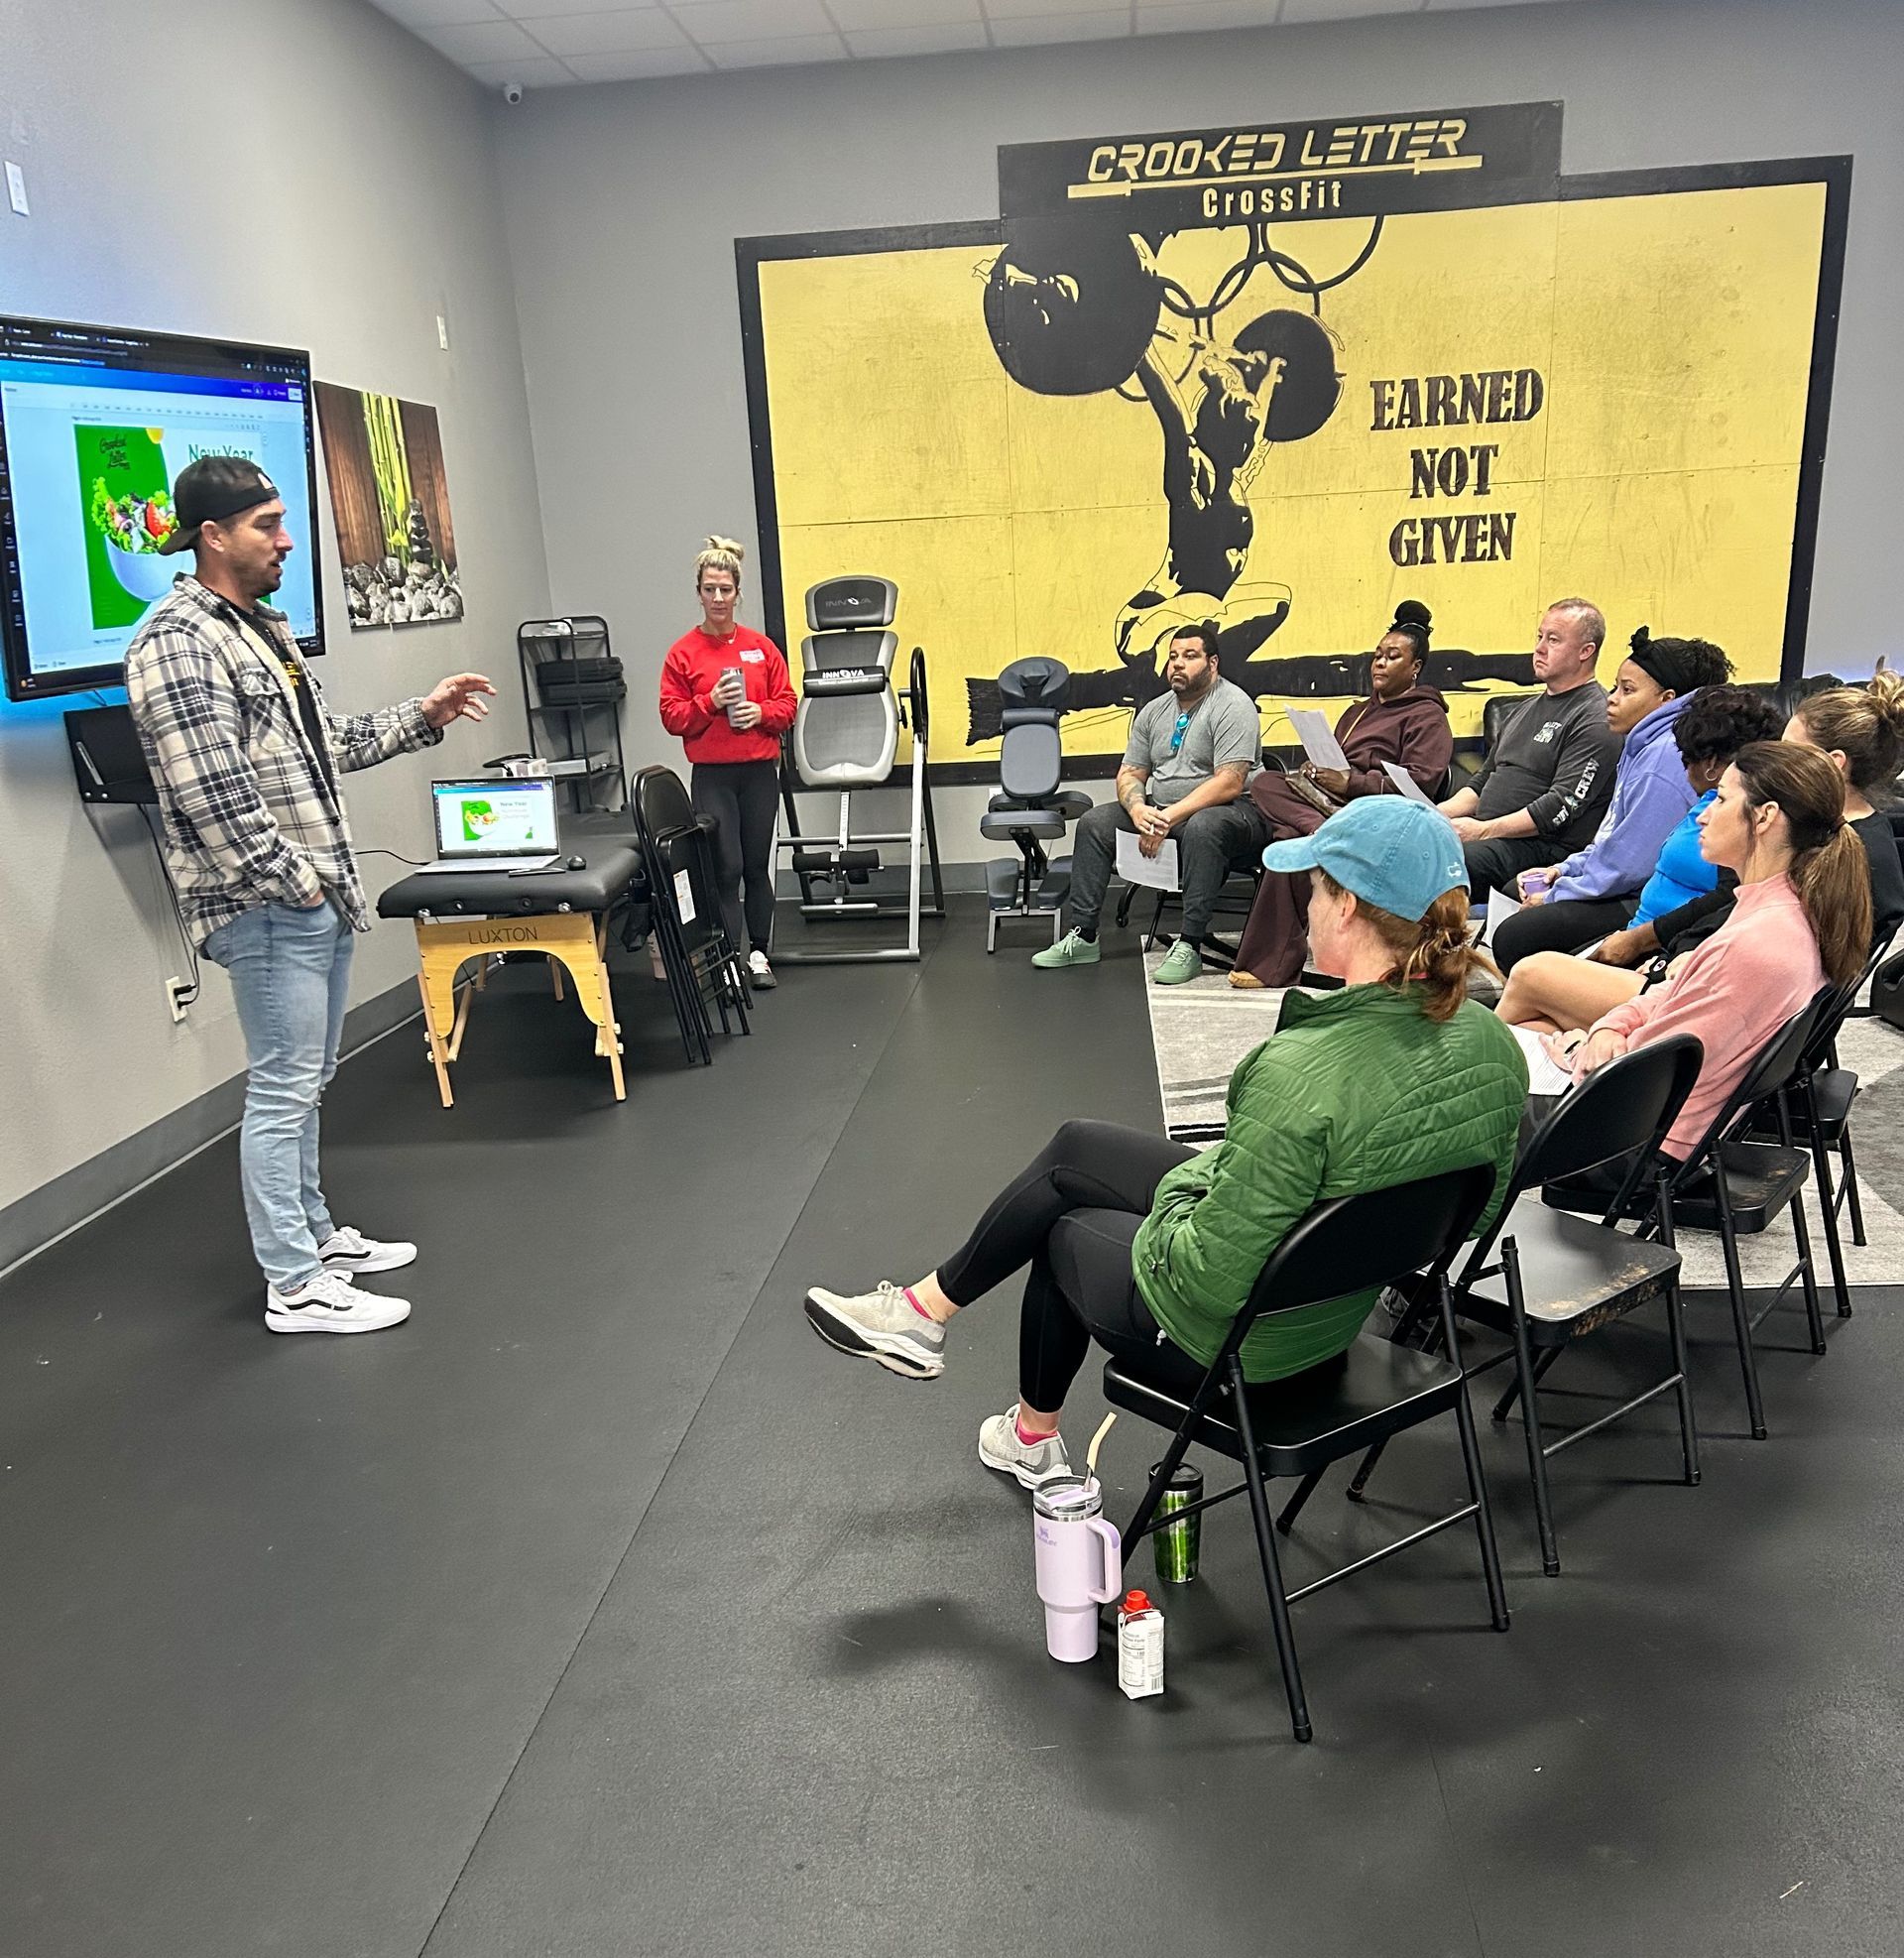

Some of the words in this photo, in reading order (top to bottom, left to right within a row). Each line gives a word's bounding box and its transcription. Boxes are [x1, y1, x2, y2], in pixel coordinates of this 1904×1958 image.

[1087, 133, 1286, 182] CROOKED
[1300, 119, 1467, 167] LETTER
[1202, 181, 1343, 218] CrossFit
[1369, 368, 1544, 430] EARNED
[1409, 444, 1499, 499] NOT
[1389, 512, 1517, 567] GIVEN
[822, 669, 865, 679] INNOVA
[1575, 758, 1600, 798] CREW
[468, 926, 538, 945] LUXTON
